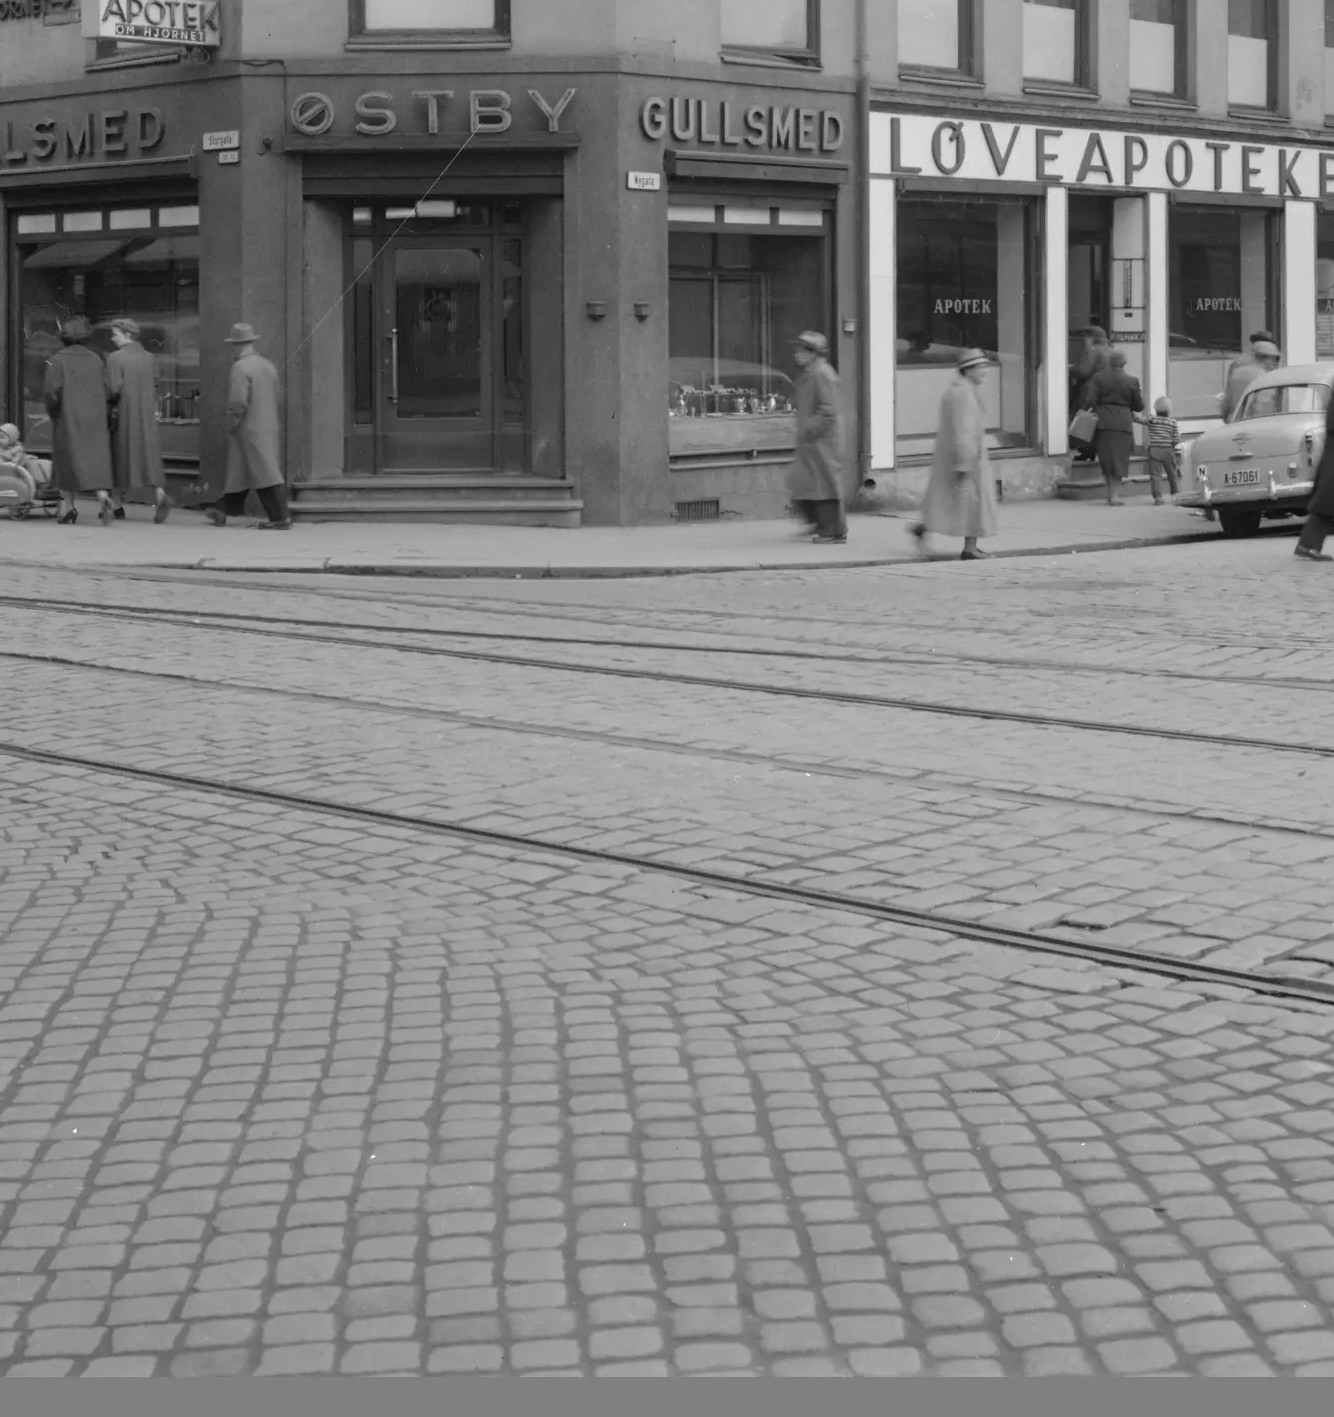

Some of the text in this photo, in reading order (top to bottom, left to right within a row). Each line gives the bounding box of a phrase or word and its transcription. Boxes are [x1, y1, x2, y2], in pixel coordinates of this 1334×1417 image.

[115, 25, 135, 35] OM
[290, 87, 577, 135] ØSTBY
[642, 96, 845, 152] GULLSMED
[933, 298, 992, 314] APOTEK
[1196, 298, 1241, 311] APOTEK
